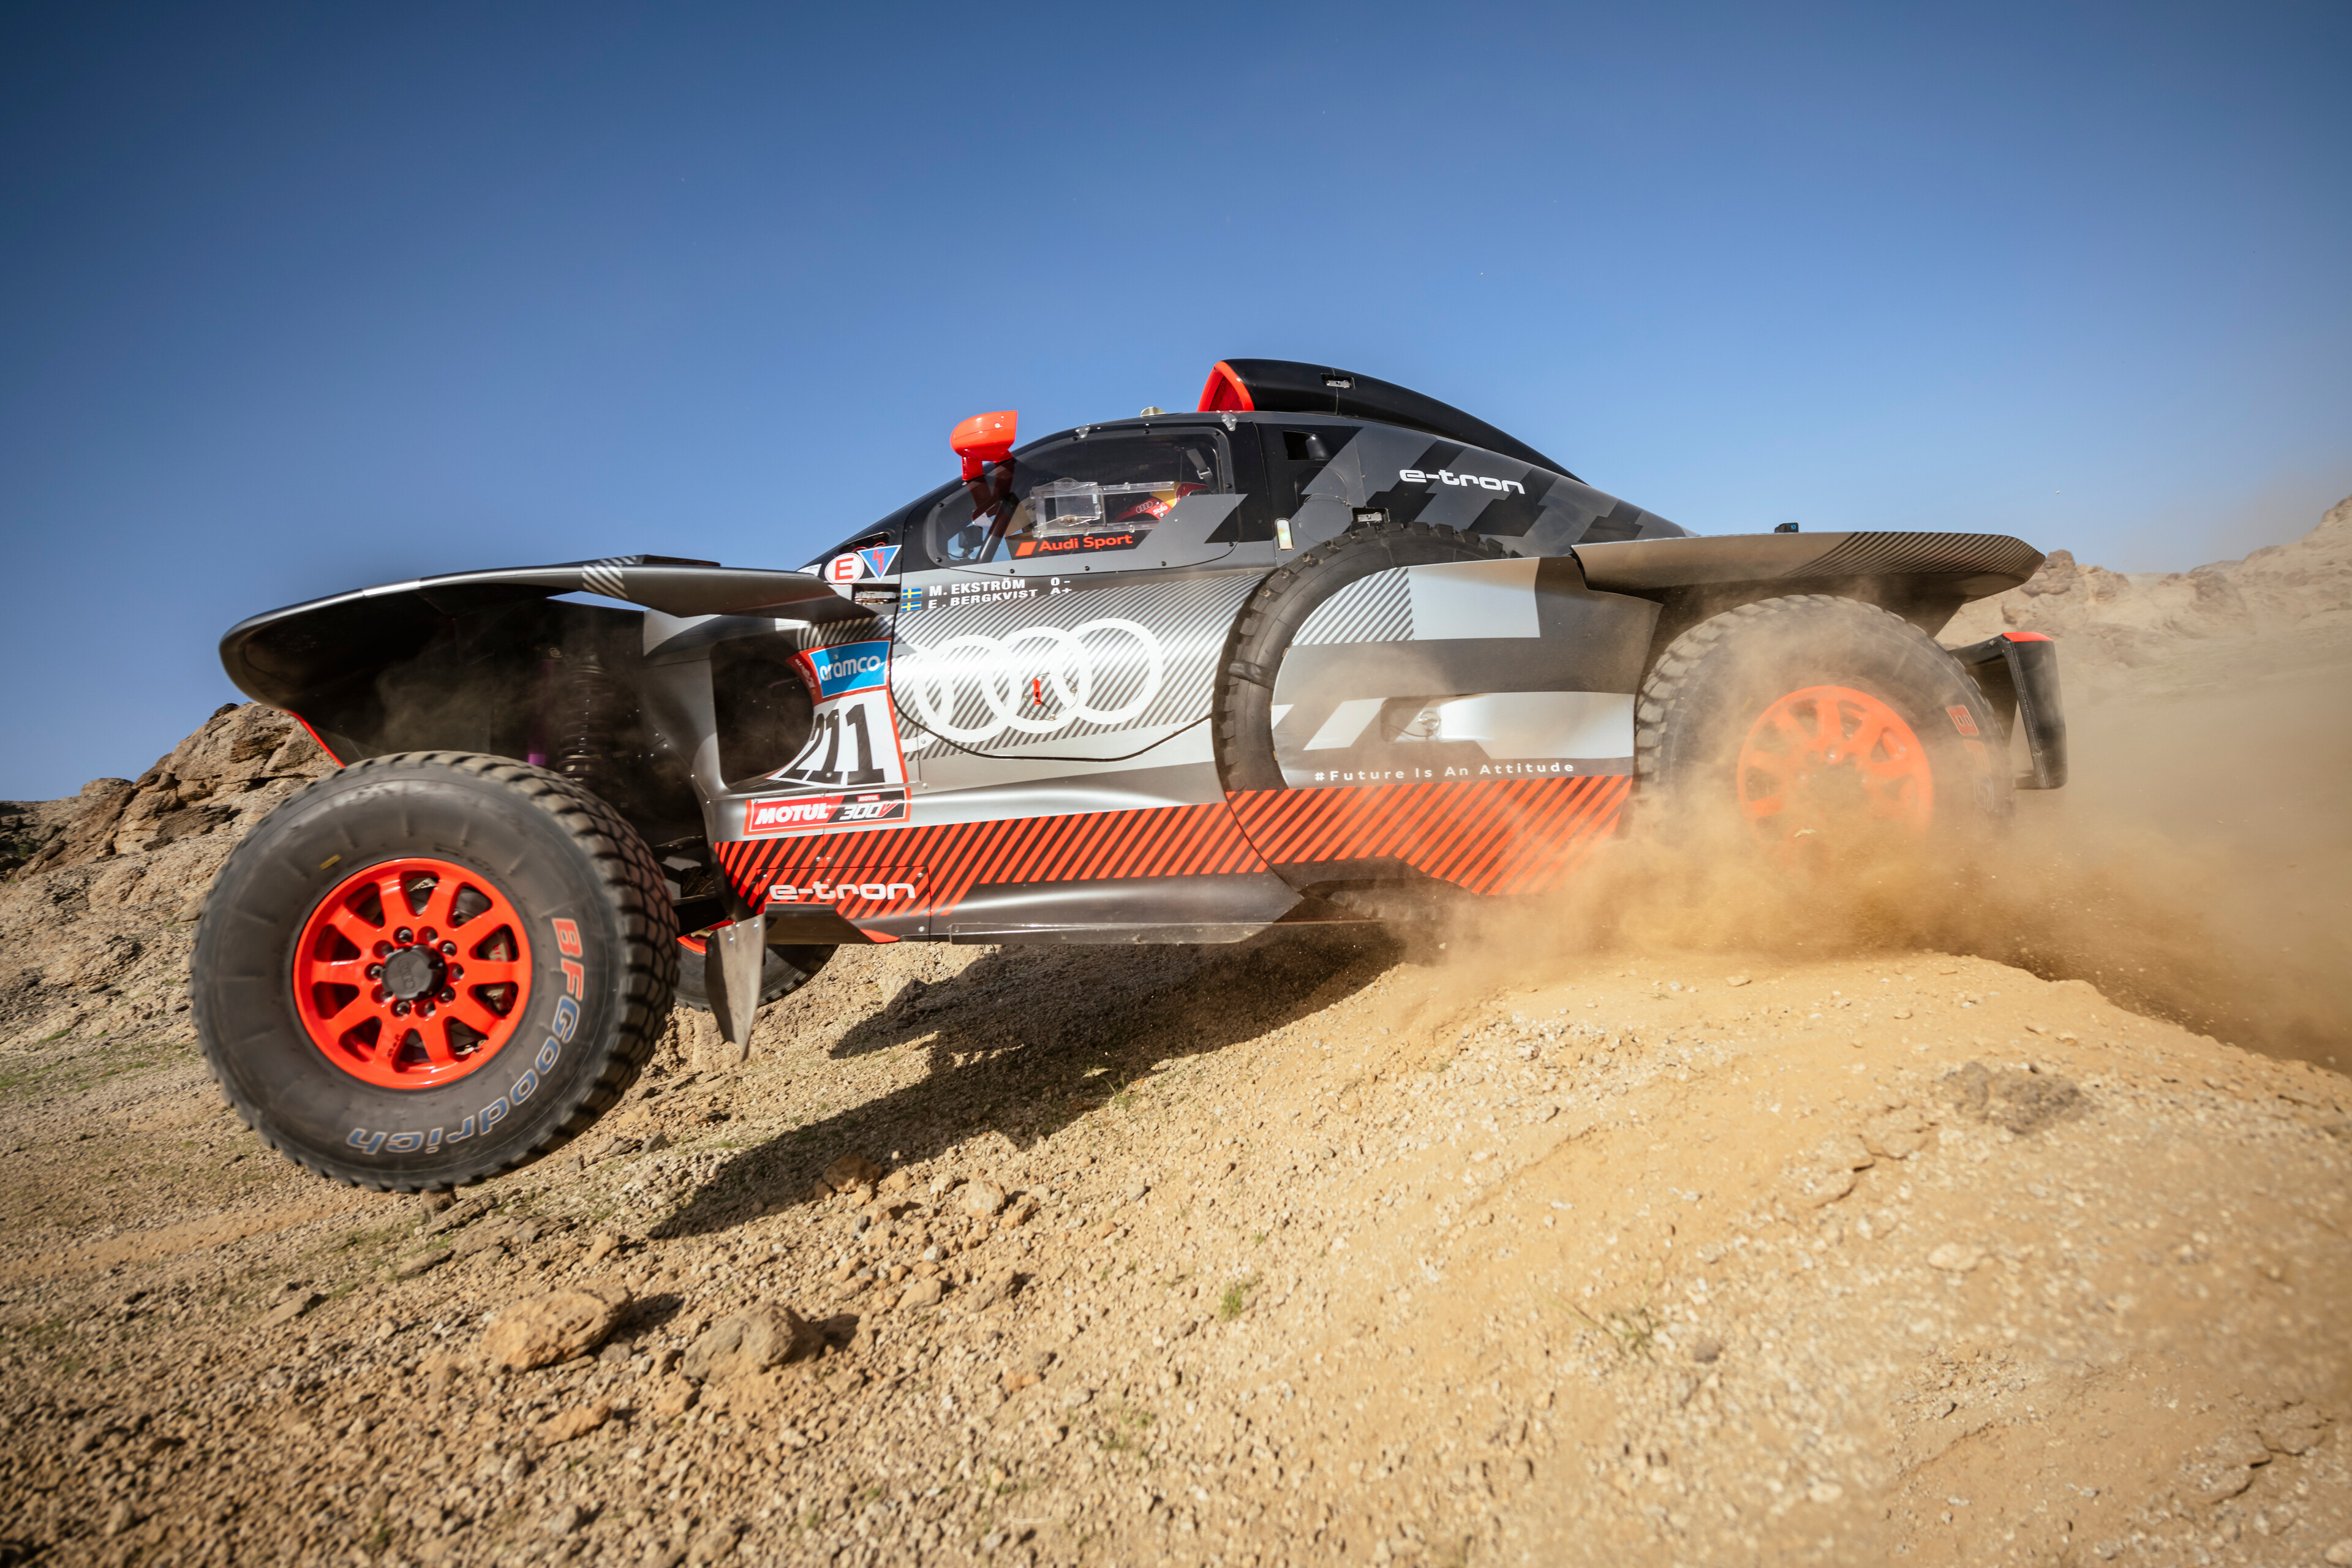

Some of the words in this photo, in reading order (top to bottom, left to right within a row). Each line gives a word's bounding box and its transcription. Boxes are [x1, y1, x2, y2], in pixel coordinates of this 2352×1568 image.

[1399, 469, 1525, 494] e-tron
[1039, 538, 1079, 551] Audi
[1083, 534, 1133, 549] Sport
[835, 557, 854, 581] E
[929, 585, 947, 597] M.
[951, 578, 1025, 595] EKSTRÖM
[950, 589, 1038, 606] BERGKVIST
[820, 655, 881, 681] aramco
[778, 704, 886, 785] 211
[1314, 769, 1404, 782] #Future
[1415, 767, 1433, 778] Is
[1444, 766, 1469, 777] An
[1479, 762, 1574, 775] Attitude
[754, 803, 829, 825] MOTUL
[839, 799, 903, 821] 300V
[769, 881, 916, 900] e-tron
[345, 918, 584, 1155] BFGoodrich
